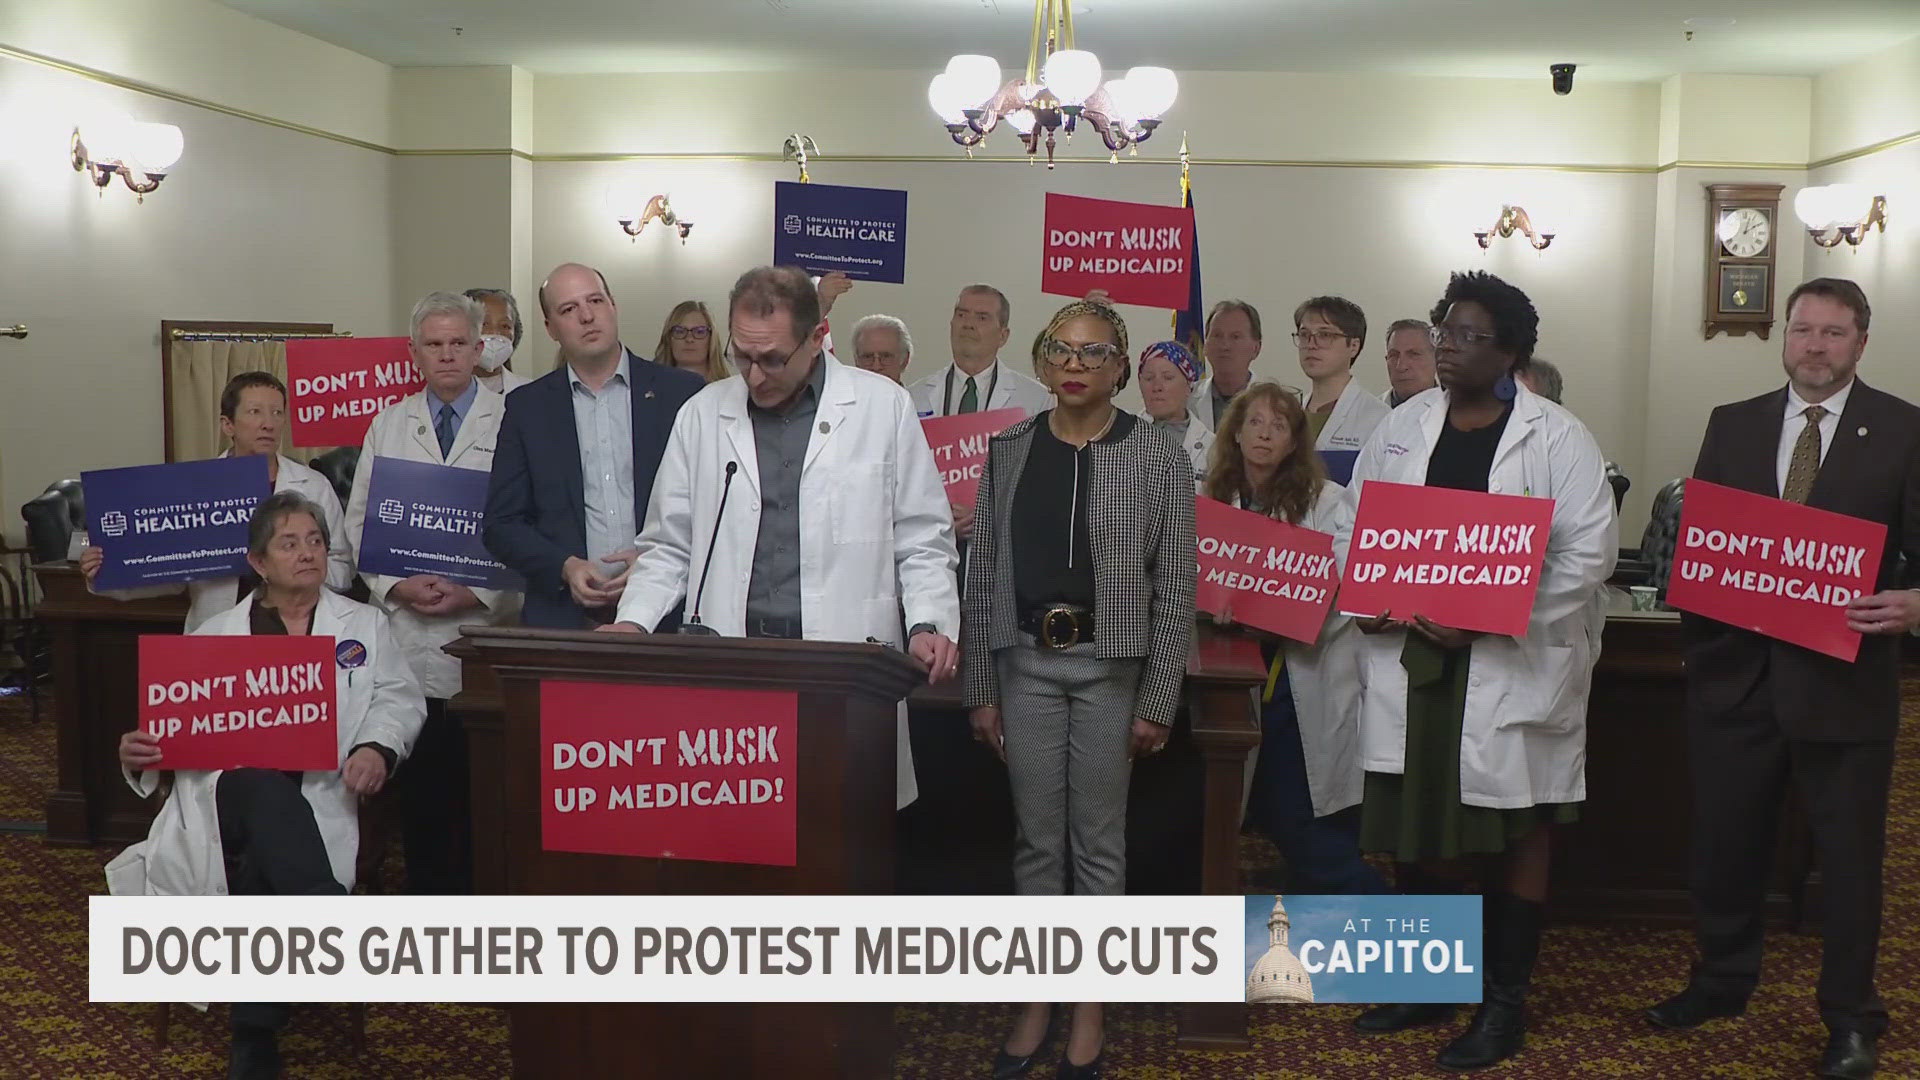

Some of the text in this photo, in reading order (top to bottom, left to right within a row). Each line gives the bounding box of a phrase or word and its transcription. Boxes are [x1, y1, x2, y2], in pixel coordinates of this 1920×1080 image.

[806, 216, 847, 226] COMMITTEE
[863, 221, 896, 229] PROTECT
[806, 224, 896, 242] HEALTH CARE
[1050, 227, 1182, 251] DON'T MUSK
[795, 252, 883, 266] www.CommitteeToProtect.org
[1049, 256, 1184, 274] UP MEDICAID!
[295, 360, 426, 397] DON'T MUS
[297, 405, 325, 423] UP
[133, 497, 258, 516] COMMITTEE TO PROTECT
[412, 502, 484, 519] COMMITTEE TO
[135, 513, 206, 534] HEALTH
[409, 512, 477, 535] HEALTH
[1359, 524, 1536, 555] DON'T MUSK
[123, 546, 248, 566] www.CommitteeToProtect.org
[1196, 536, 1335, 580] ON'T MUSK
[1685, 526, 1866, 578] DON'T MUSK
[1353, 563, 1532, 585] UP MEDICAID!
[1680, 560, 1714, 582] UP
[1205, 567, 1327, 604] MEDICAID!
[147, 661, 324, 706] DON'T MUSK
[148, 701, 329, 739] UP MEDICAID!
[553, 725, 779, 770] DON'T MUSK
[554, 777, 784, 813] UP MEDICAID!
